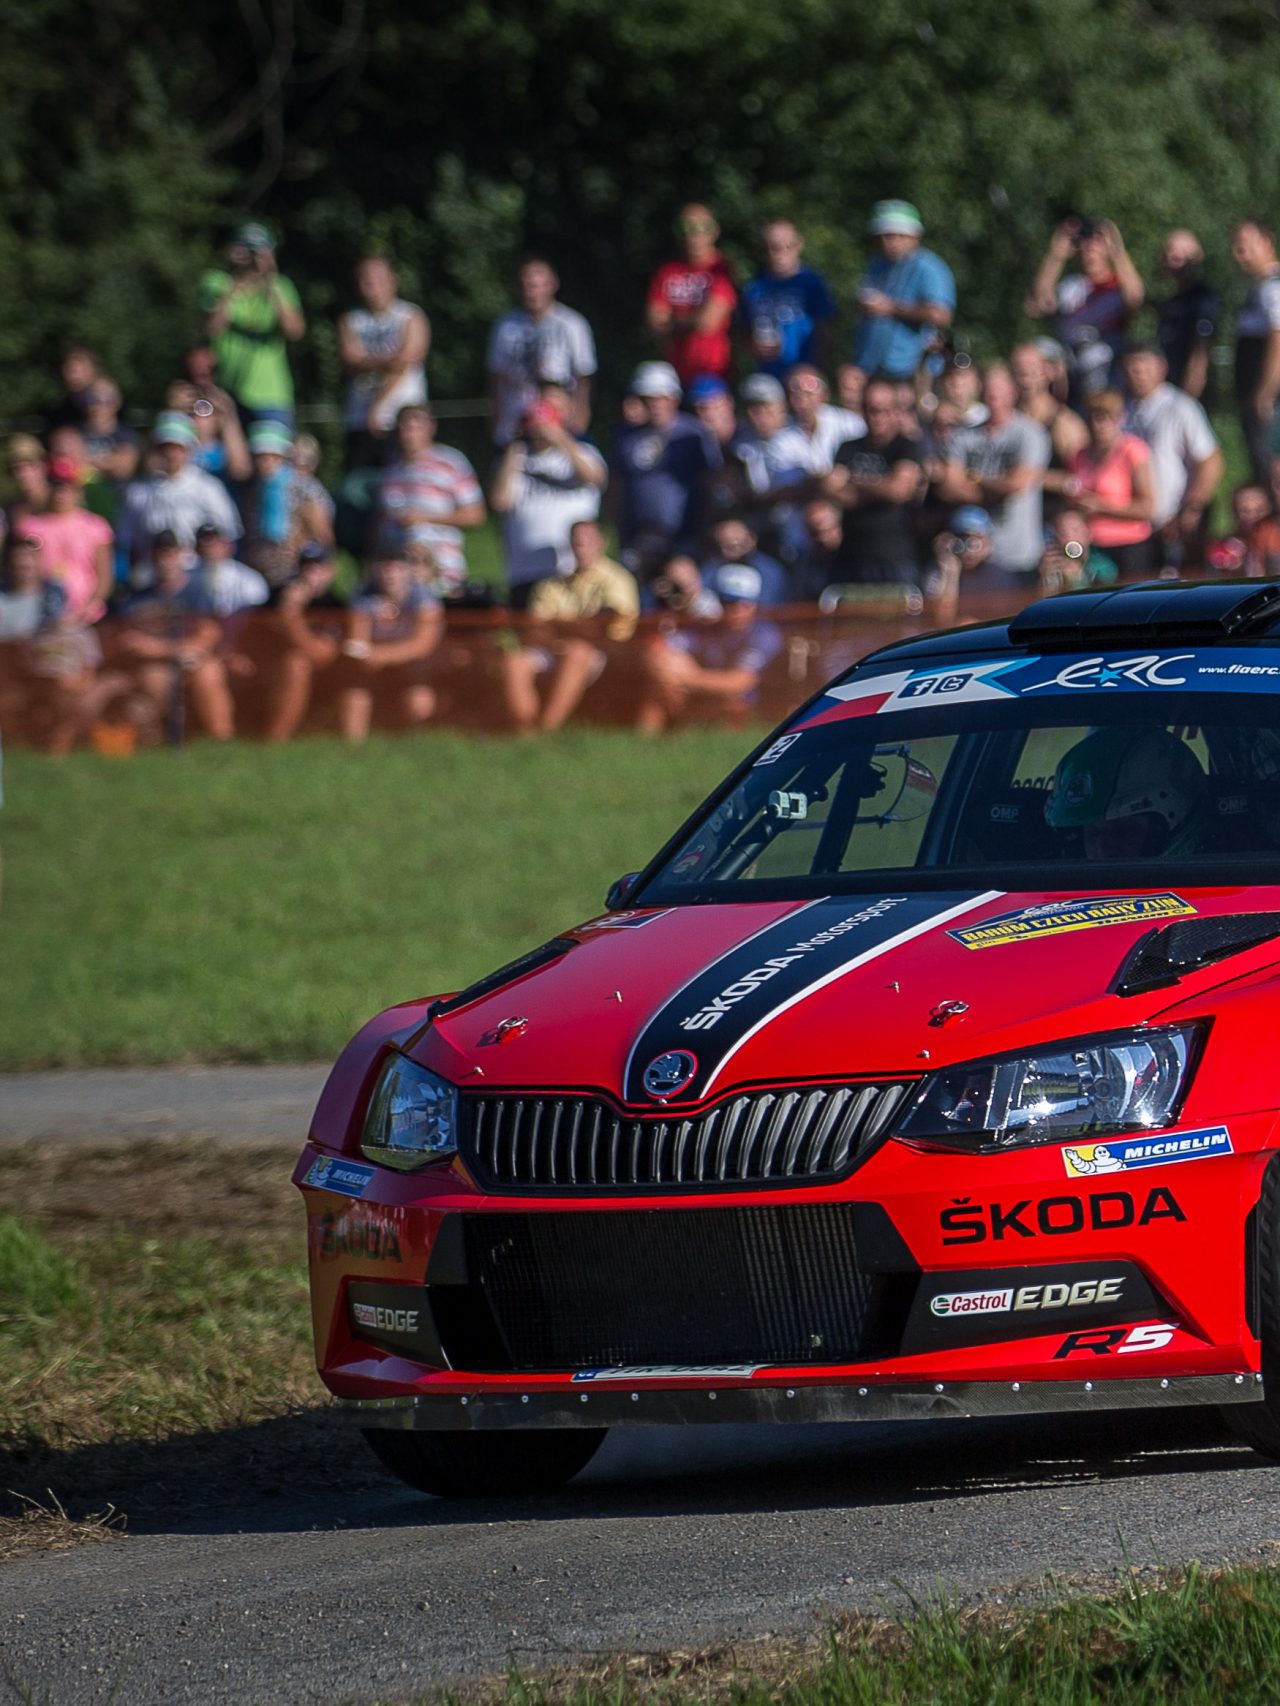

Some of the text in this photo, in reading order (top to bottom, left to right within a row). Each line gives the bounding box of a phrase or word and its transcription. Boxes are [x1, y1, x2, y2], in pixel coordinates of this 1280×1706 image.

[1022, 655, 1196, 692] ERC
[786, 897, 908, 952] Motorsport
[961, 922, 1031, 941] BARUM
[1030, 911, 1089, 928] CZECH
[1086, 903, 1138, 919] RALLY
[680, 954, 805, 1030] ŠKODA
[1124, 1133, 1227, 1159] MICHELIN
[939, 1186, 1188, 1246] ŠKODA
[951, 1277, 1127, 1313] Castrol EDGE
[376, 1307, 420, 1332] EDGE
[1052, 1321, 1182, 1360] R5
